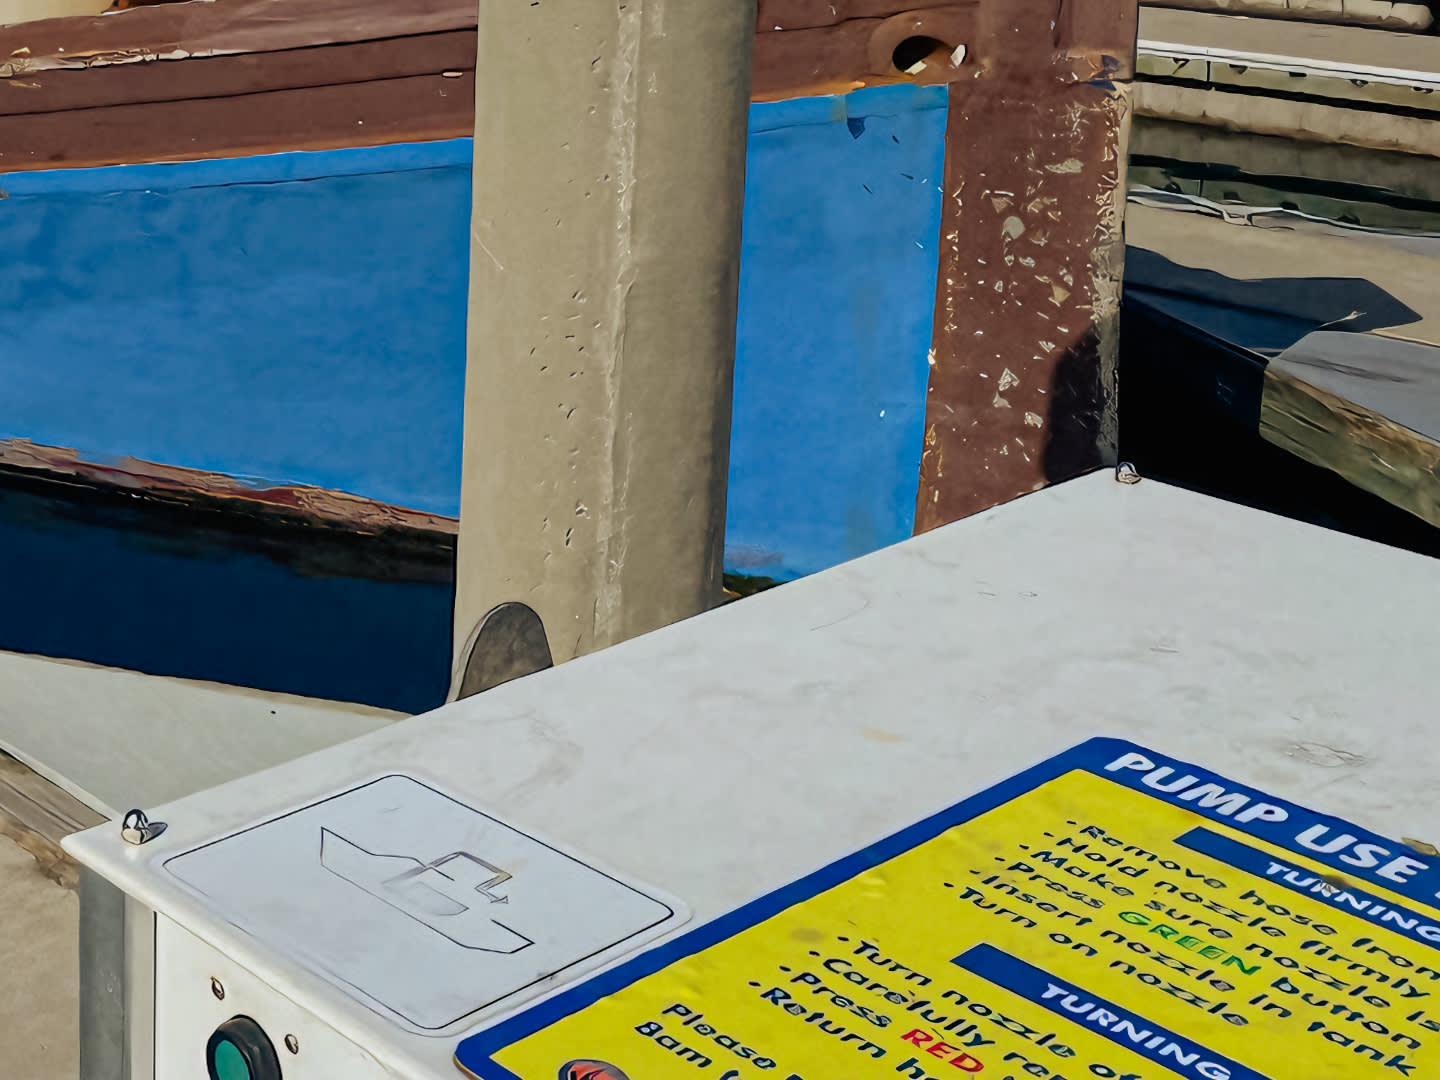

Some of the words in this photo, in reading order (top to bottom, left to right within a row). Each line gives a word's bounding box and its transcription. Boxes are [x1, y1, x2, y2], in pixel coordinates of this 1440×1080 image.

[1103, 752, 1289, 823] PUMP
[1294, 823, 1429, 883] USE
[1154, 880, 1287, 938] nozzle
[1300, 940, 1431, 998] firmly
[1239, 889, 1337, 936] hose
[1264, 861, 1440, 943] TURNING
[1049, 933, 1099, 957] on
[1109, 960, 1249, 1025] nozzle
[1118, 911, 1262, 976] GREEN
[1270, 976, 1422, 1049] button
[1143, 899, 1233, 939] sure
[1244, 943, 1391, 1008] nozzle
[661, 1003, 777, 1070] Please
[900, 1028, 985, 1073] RED
[941, 990, 1076, 1058] nozzle
[1040, 982, 1232, 1080] TURNING
[1100, 930, 1235, 992] nozzle
[1248, 993, 1293, 1018] in
[1306, 1021, 1417, 1077] tank
